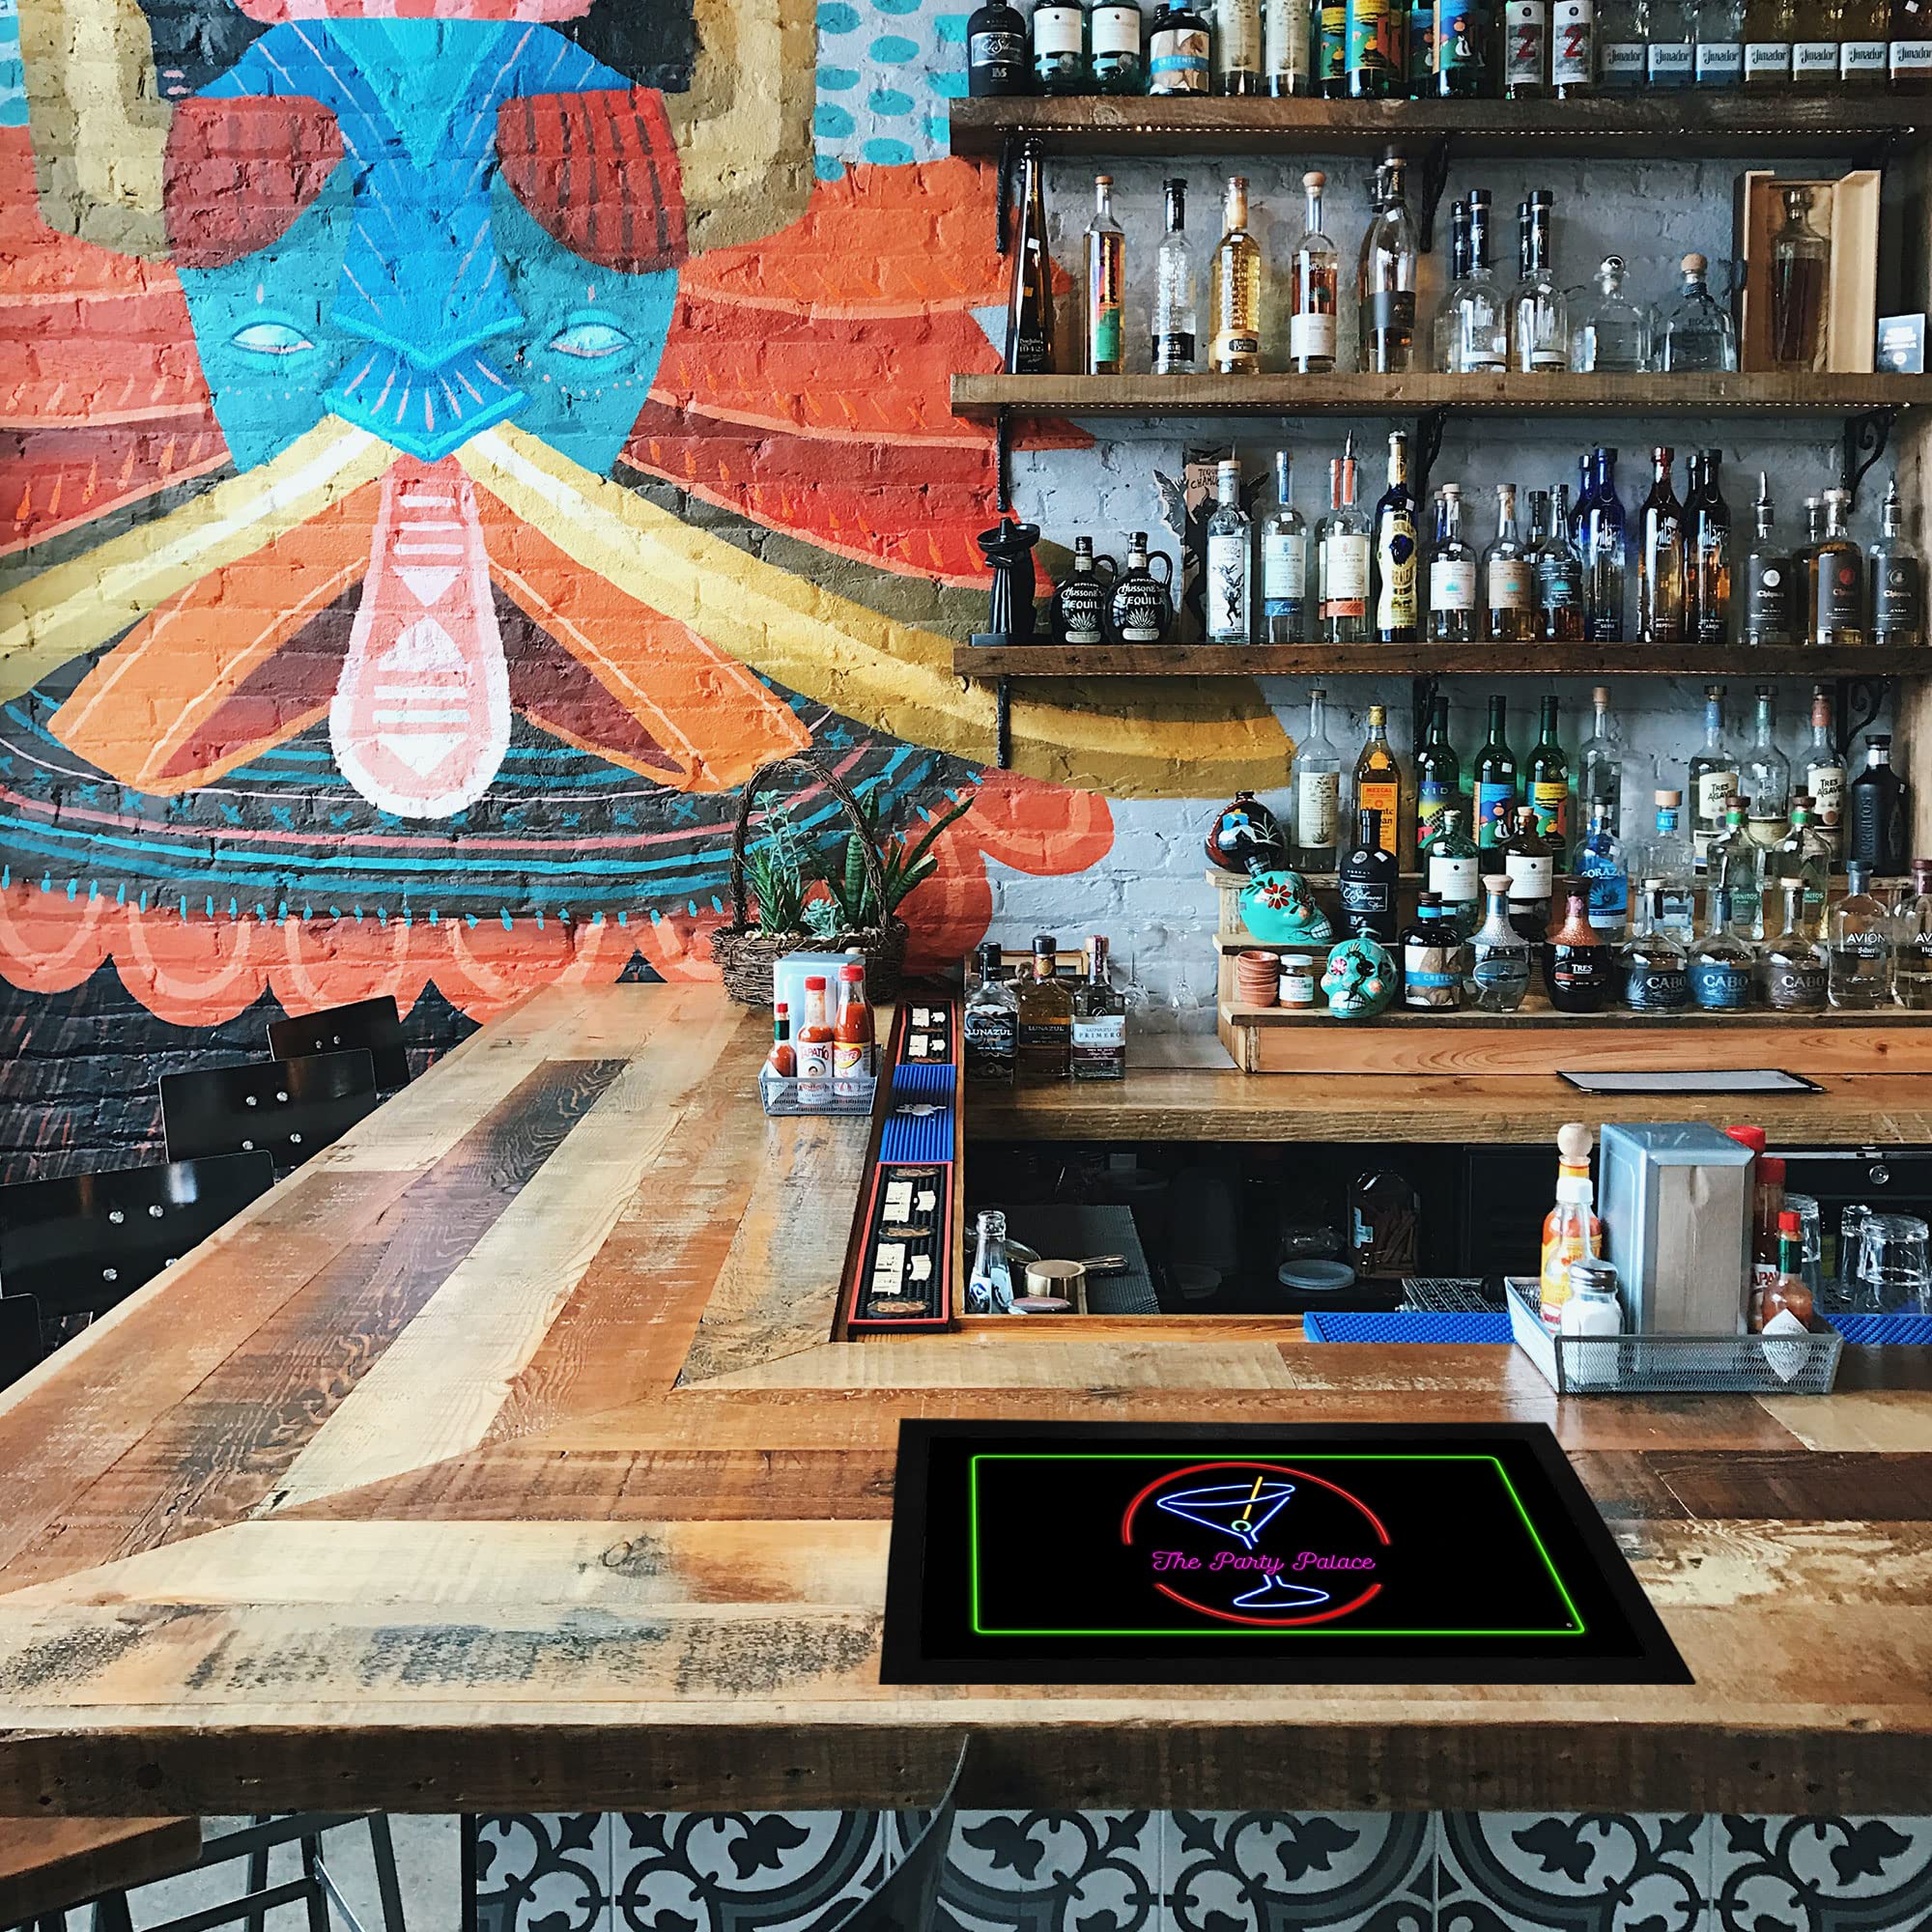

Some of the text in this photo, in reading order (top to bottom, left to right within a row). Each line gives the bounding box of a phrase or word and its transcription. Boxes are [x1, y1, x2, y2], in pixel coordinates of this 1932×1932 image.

[1191, 476, 1219, 489] CHAMUC
[1065, 598, 1100, 610] TEQUIL
[1711, 783, 1730, 792] TRES
[1820, 779, 1839, 787] TRES
[1581, 867, 1623, 879] CORAZ
[1646, 976, 1686, 989] CABO
[1702, 975, 1748, 988] CABO
[1780, 975, 1825, 988] CABO
[1152, 1550, 1377, 1576] The Party Palace
